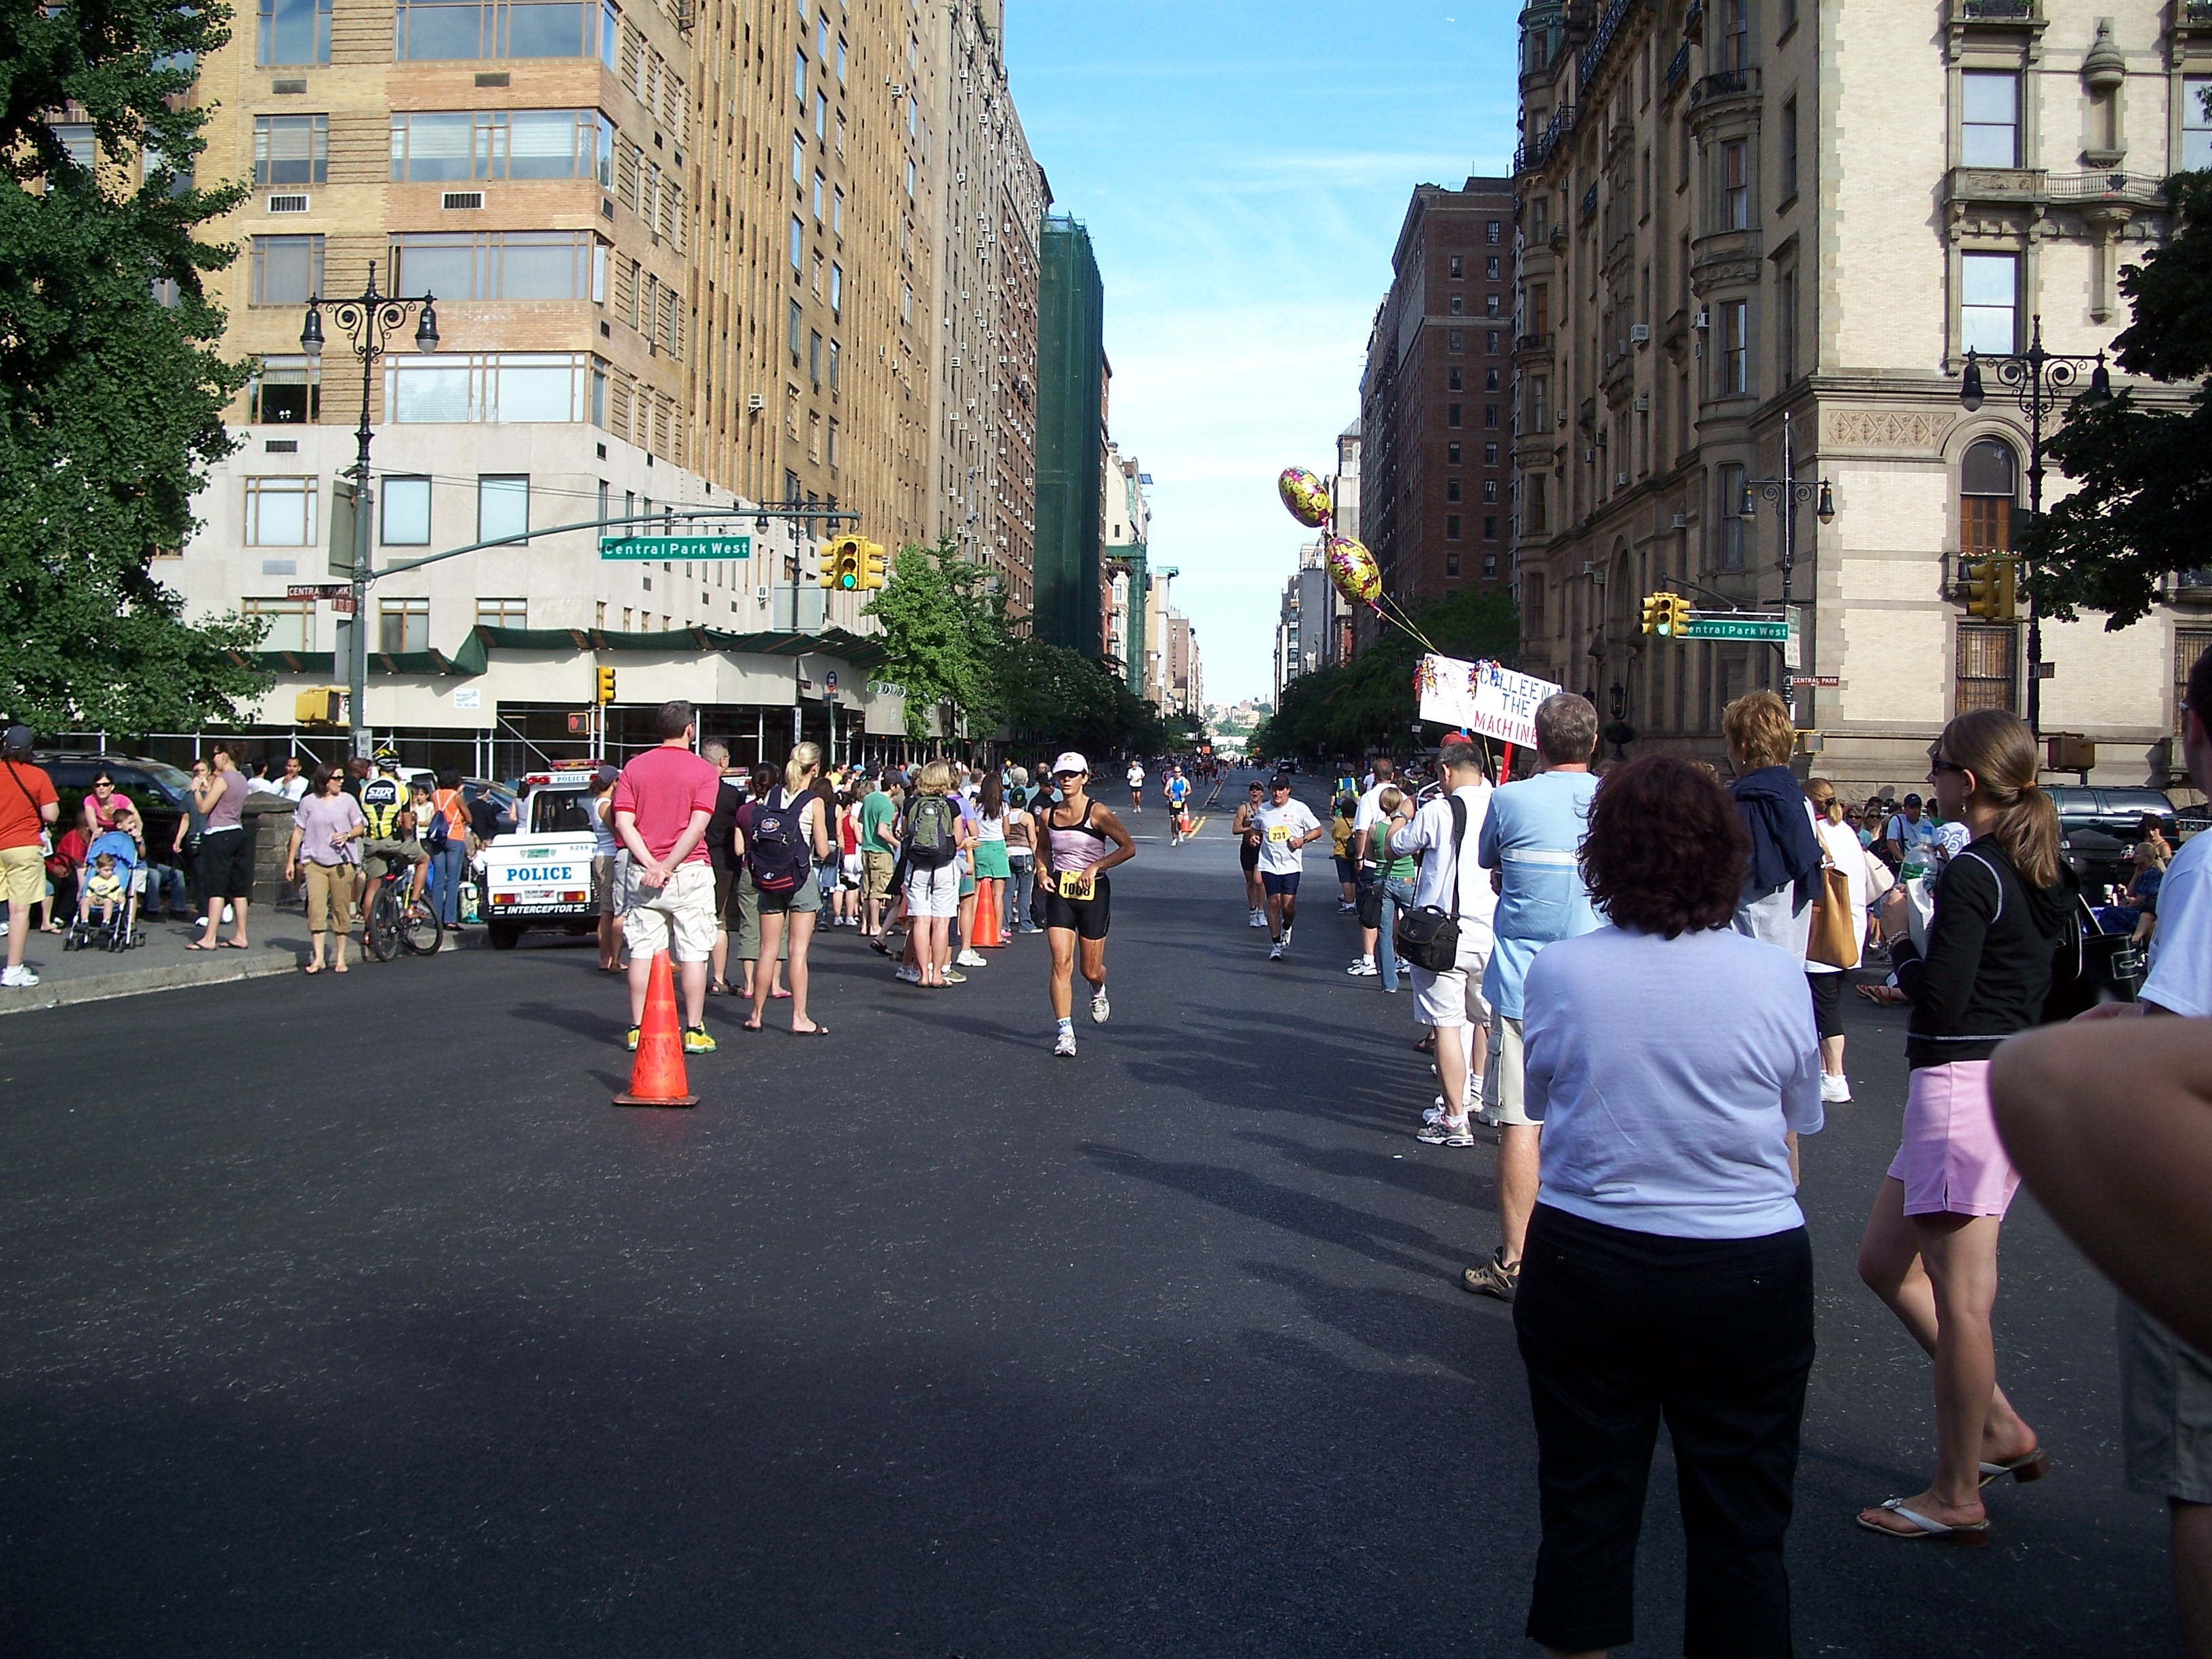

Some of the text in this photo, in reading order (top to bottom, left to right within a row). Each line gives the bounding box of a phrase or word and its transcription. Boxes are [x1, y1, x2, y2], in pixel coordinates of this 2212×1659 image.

[605, 542, 747, 555] Central Park West
[288, 586, 349, 596] CENTRAL PARK
[1688, 626, 1787, 636] entral Park West
[1502, 692, 1531, 718] THE
[1473, 710, 1538, 745] MACHINE
[367, 787, 394, 797] SBR
[1273, 832, 1286, 840] 234
[507, 866, 572, 881] POLICE
[507, 904, 573, 915] INTERCEPTOR
